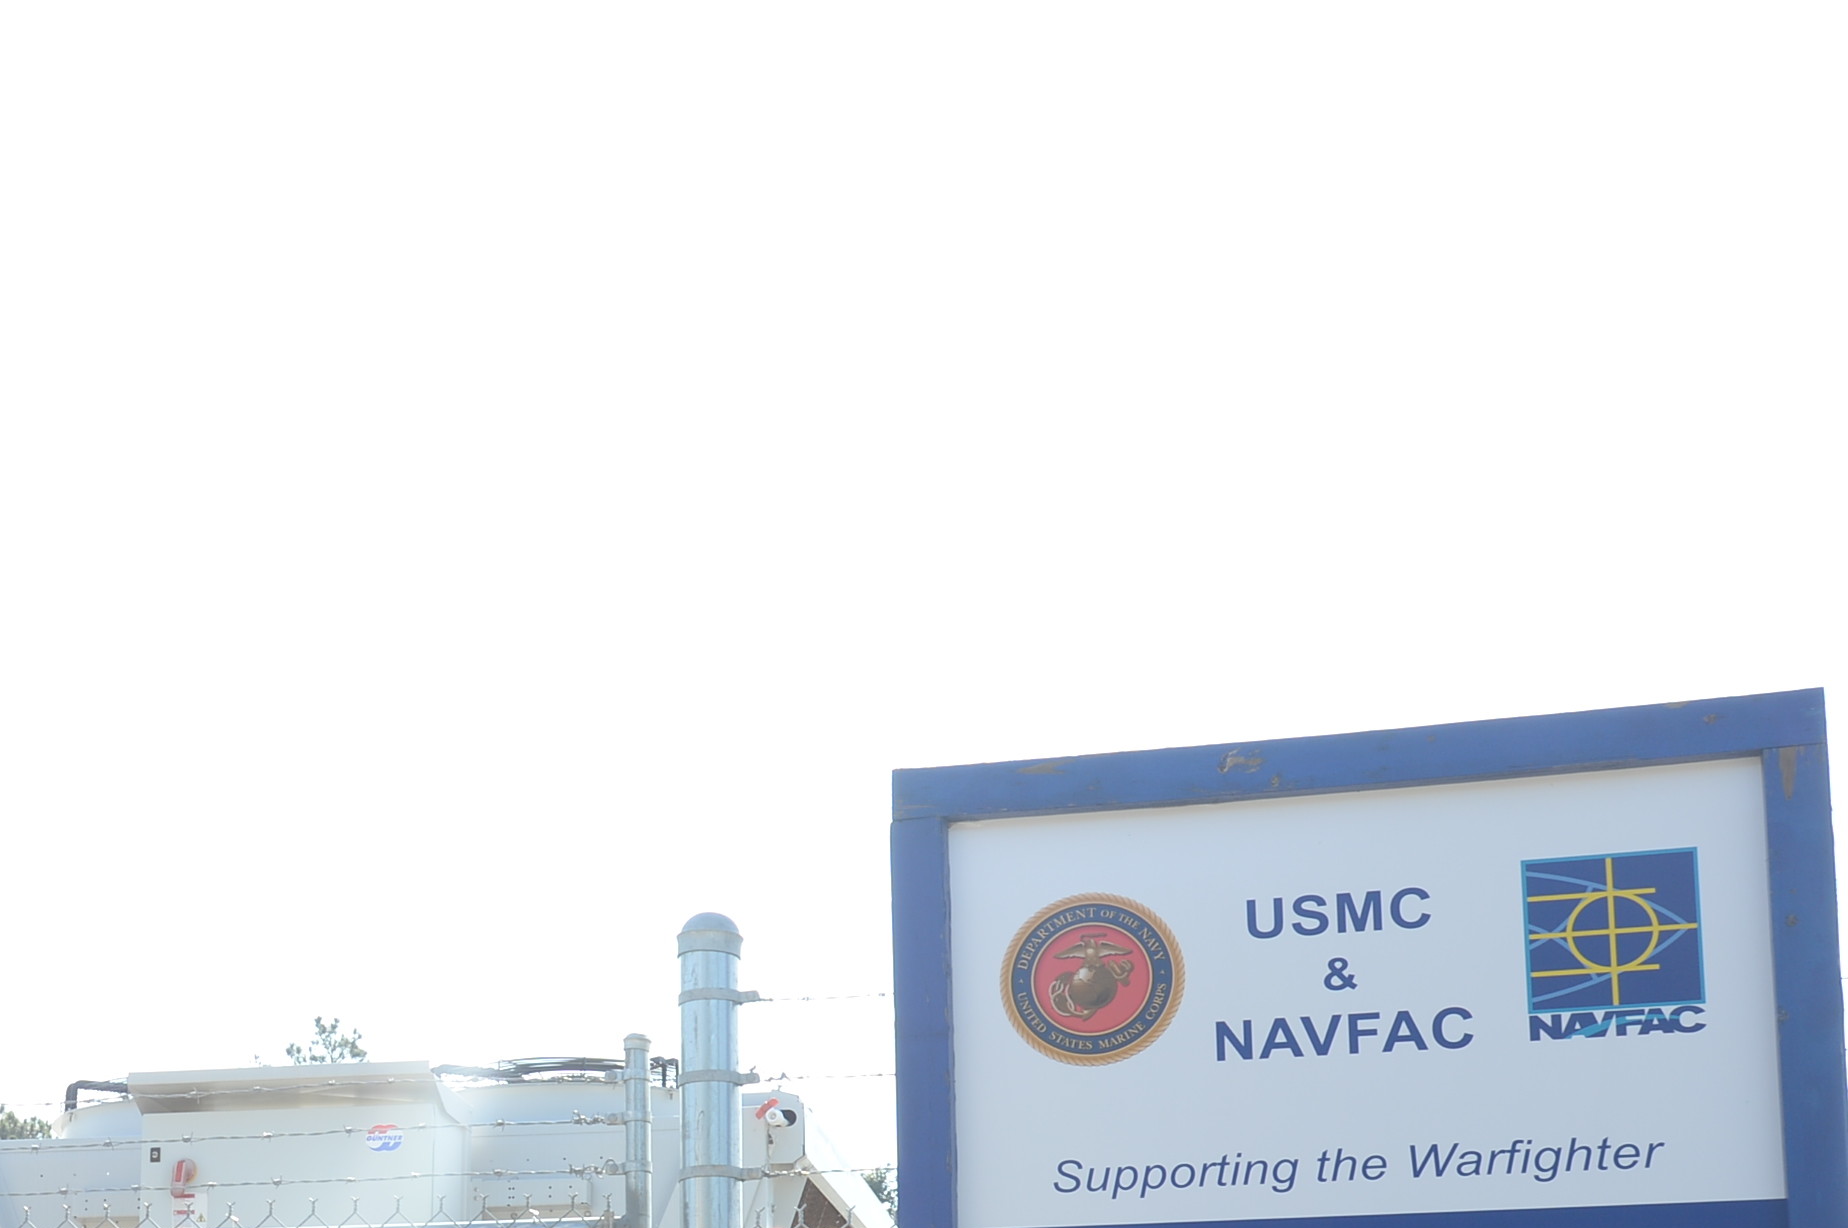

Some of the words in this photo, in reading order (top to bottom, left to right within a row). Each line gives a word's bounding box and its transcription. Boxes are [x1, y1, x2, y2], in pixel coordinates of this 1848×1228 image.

[1017, 907, 1097, 970] DEPARTMENT
[1100, 909, 1116, 919] OF
[1118, 913, 1140, 929] THE
[1140, 928, 1165, 961] NAVY
[1247, 888, 1430, 938] USMC
[1324, 958, 1357, 990] &
[1017, 992, 1047, 1033] UNITED
[1049, 1031, 1092, 1049] STATES
[1099, 1021, 1146, 1049] MARINE
[1145, 983, 1167, 1021] CORPS
[1216, 1007, 1473, 1061] NAVFAC
[1529, 1005, 1707, 1041] NAVFAC
[1054, 1153, 1298, 1199] Supporting
[1318, 1149, 1386, 1182] the
[1410, 1138, 1664, 1182] Warfighter
